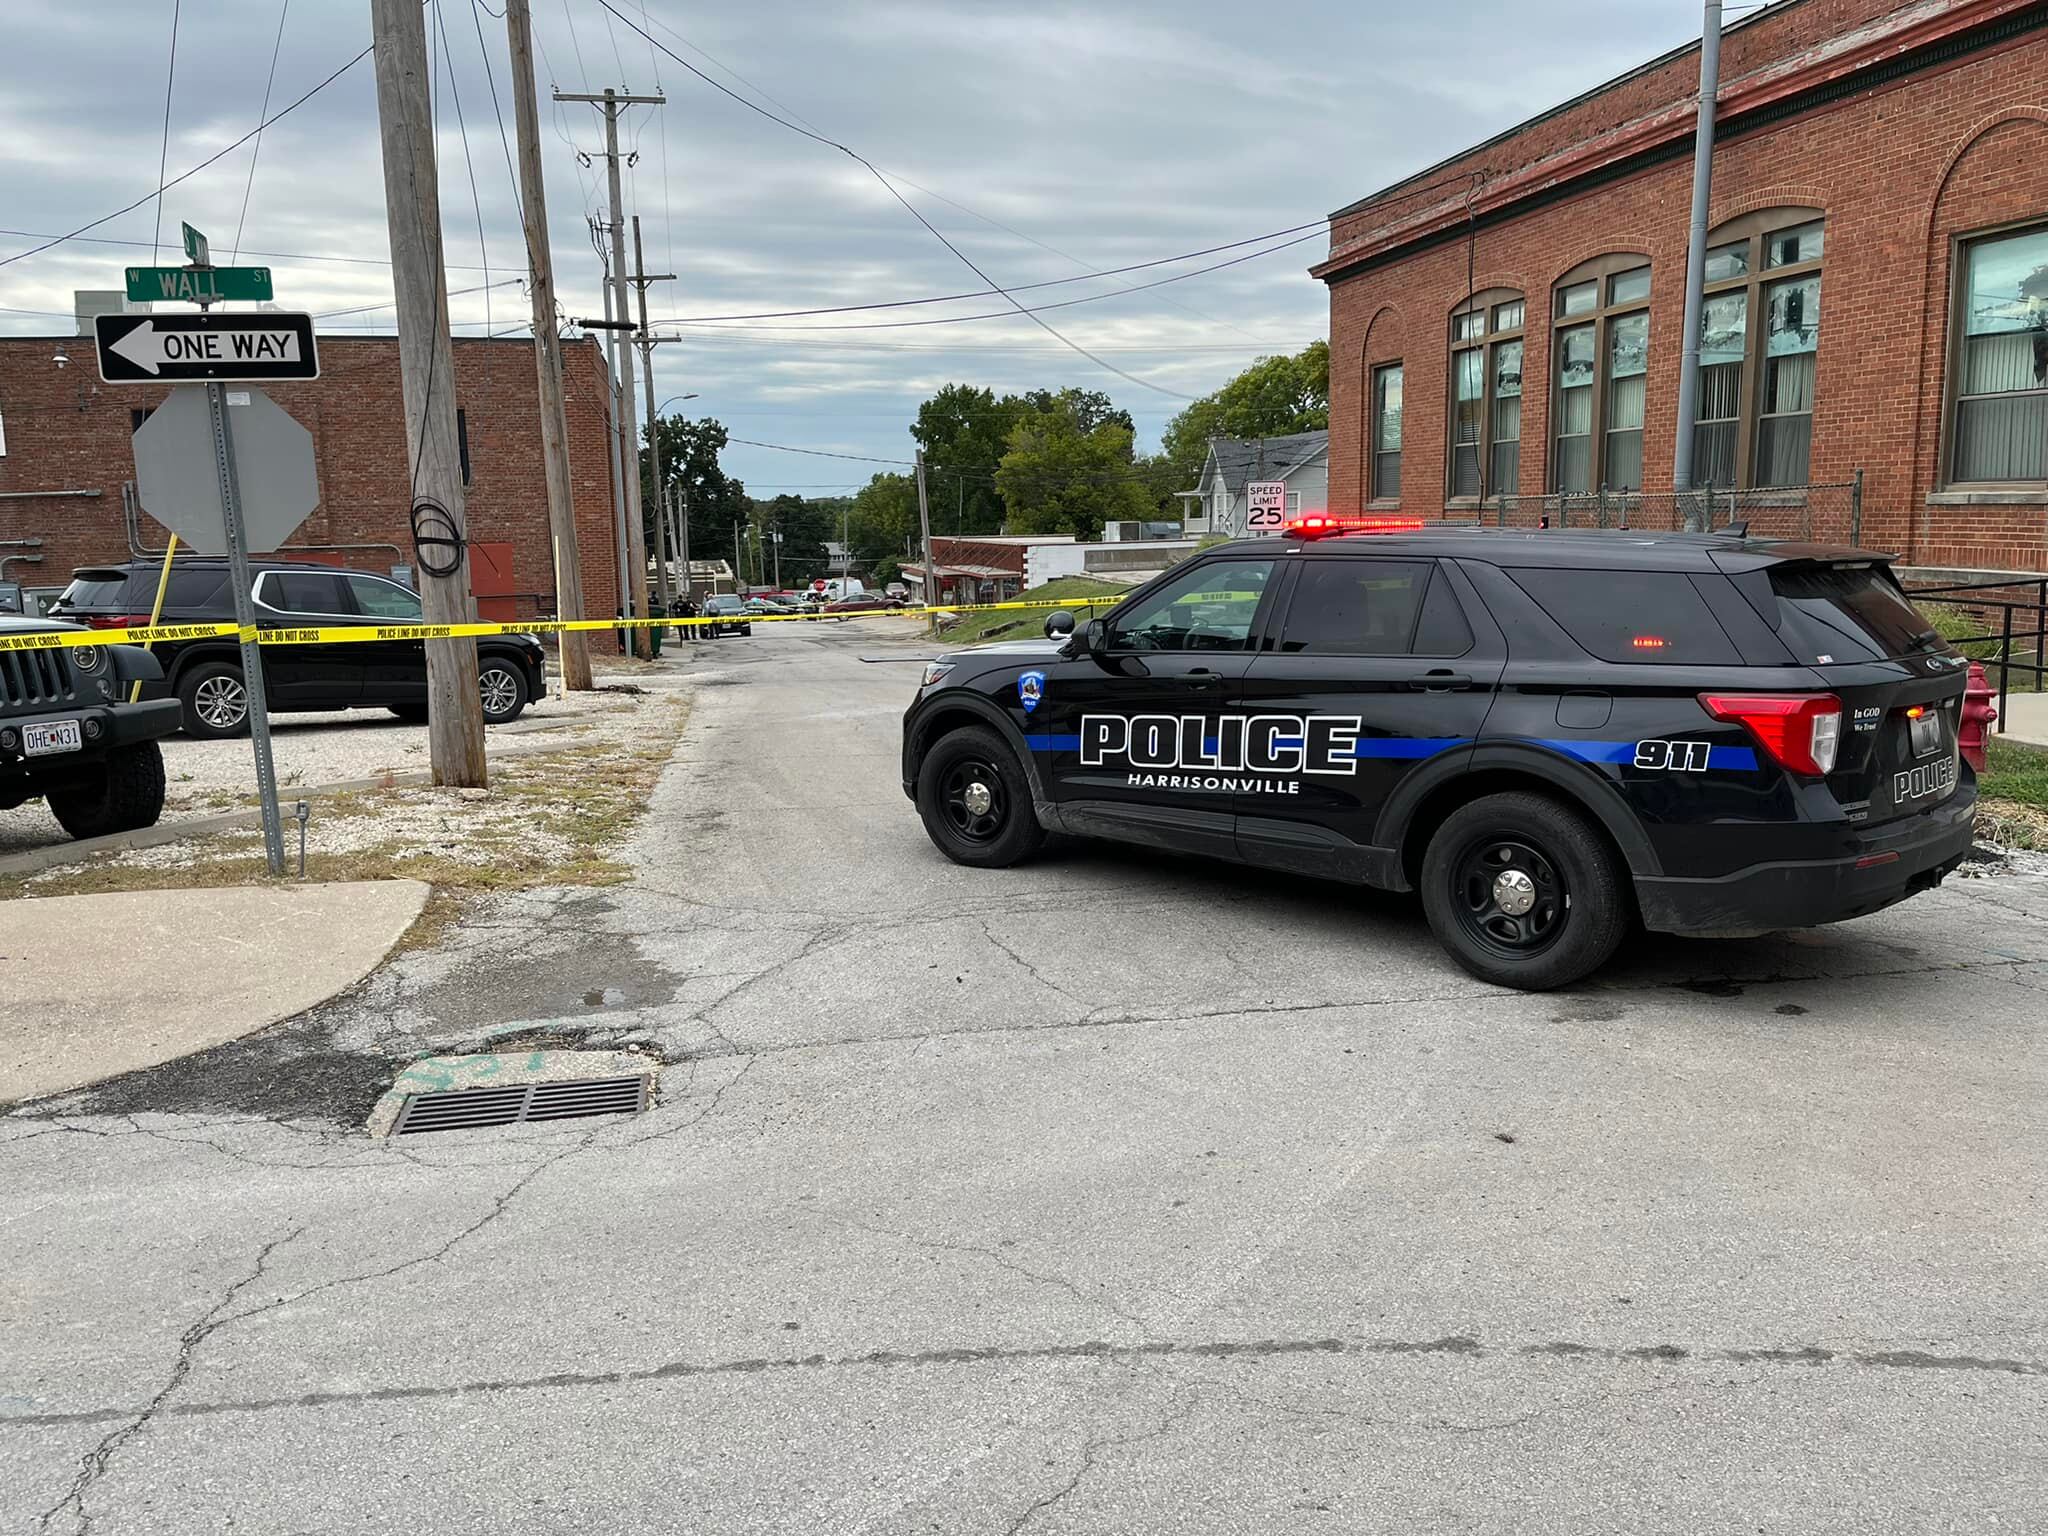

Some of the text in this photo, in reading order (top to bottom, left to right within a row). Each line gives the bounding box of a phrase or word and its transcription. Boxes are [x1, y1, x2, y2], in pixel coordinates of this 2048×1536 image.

[129, 270, 269, 298] W WALL ST
[164, 334, 291, 359] ONE WAY
[1250, 487, 1282, 495] SPEED
[1253, 497, 1278, 505] LIMIT
[1249, 507, 1282, 525] 25
[127, 625, 217, 640] POLICE LINE DO NOT CROSS
[260, 629, 320, 642] LINE DO NOT CROSS
[377, 626, 451, 639] POLICE LINE DO NOT CROSS
[12, 638, 22, 649] DO
[22, 637, 38, 648] NOT
[38, 635, 62, 647] CROSS
[1854, 707, 1880, 719] In GOD
[1854, 723, 1877, 732] We Trust
[56, 727, 78, 745] N31
[1080, 714, 1362, 775] POLICE
[1634, 740, 1711, 772] 911
[1127, 773, 1300, 795] HARRISONVILLE
[1894, 756, 1954, 804] POLICE
